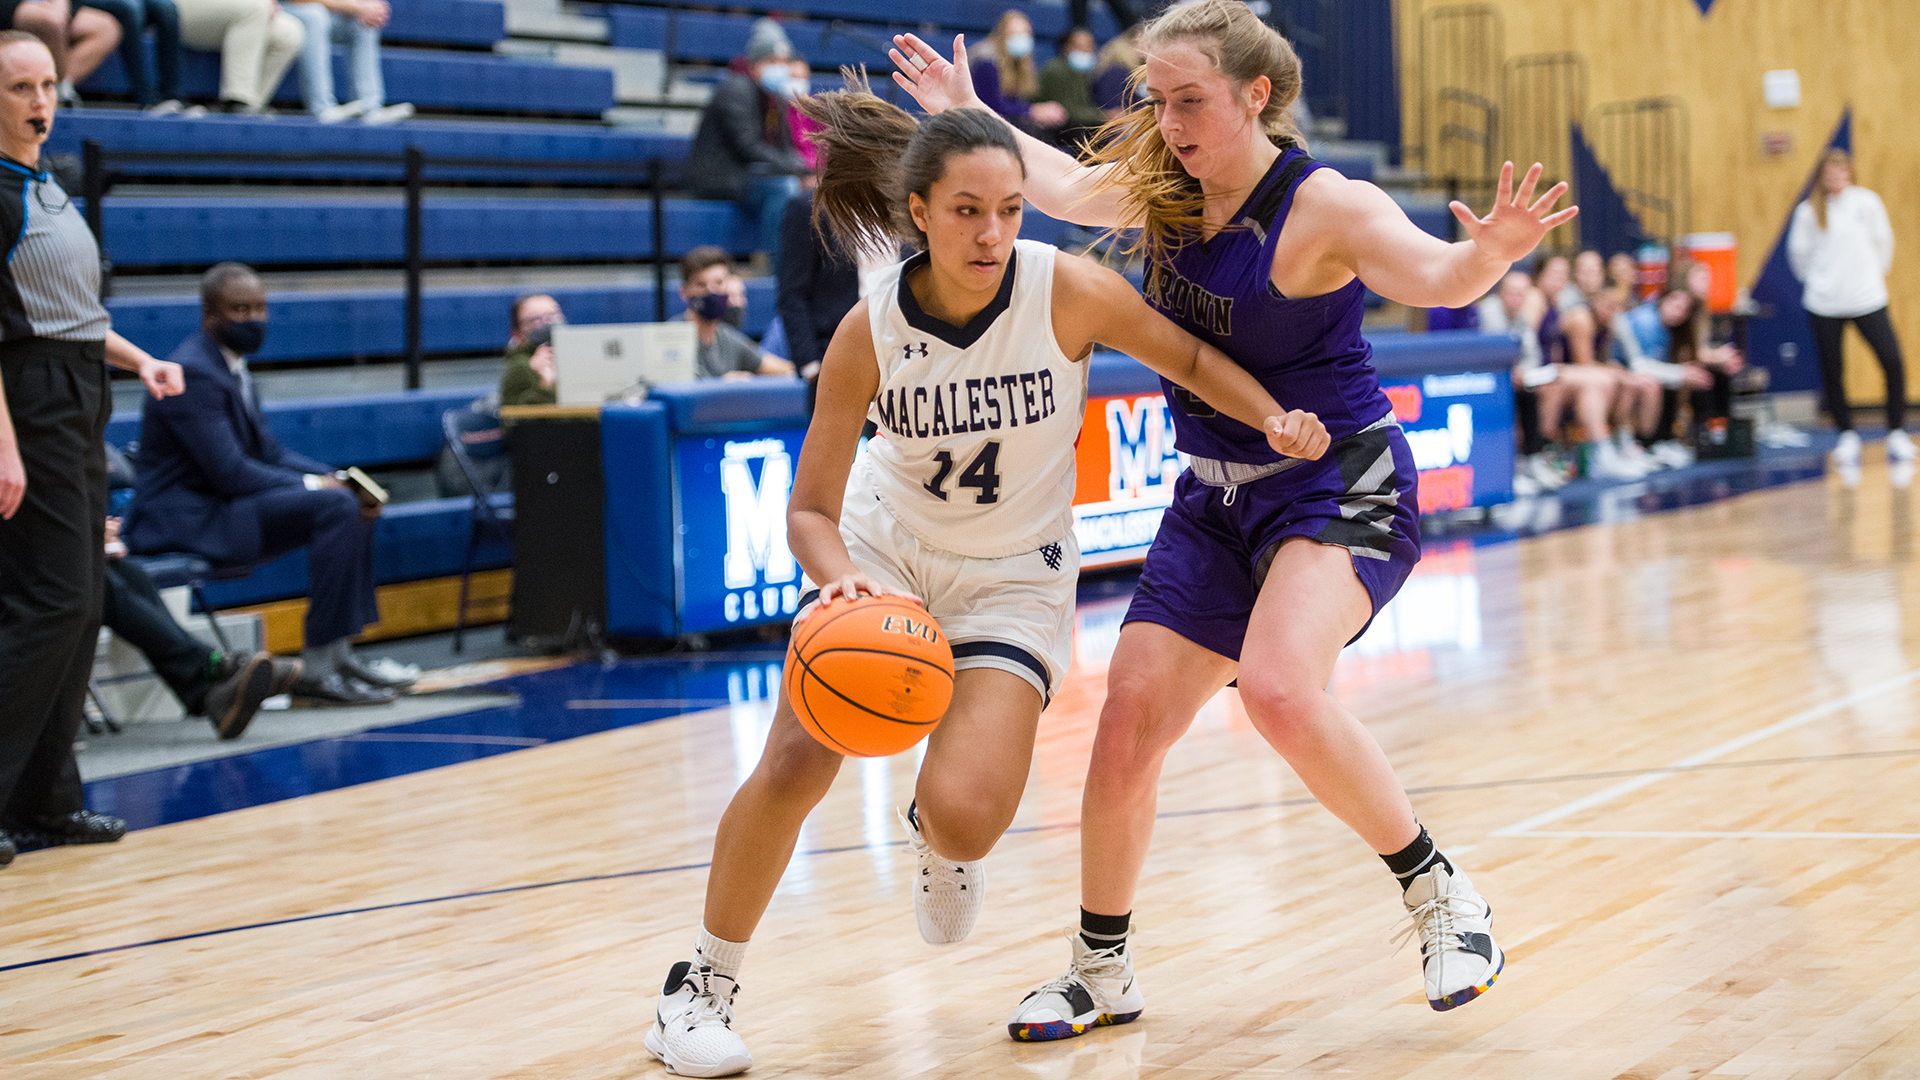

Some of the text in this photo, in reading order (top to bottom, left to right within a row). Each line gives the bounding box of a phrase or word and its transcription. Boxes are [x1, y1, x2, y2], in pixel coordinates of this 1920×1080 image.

[877, 368, 1056, 438] MACALESTER
[923, 437, 1003, 505] 14
[720, 452, 797, 589] M
[881, 614, 938, 645] EVO
